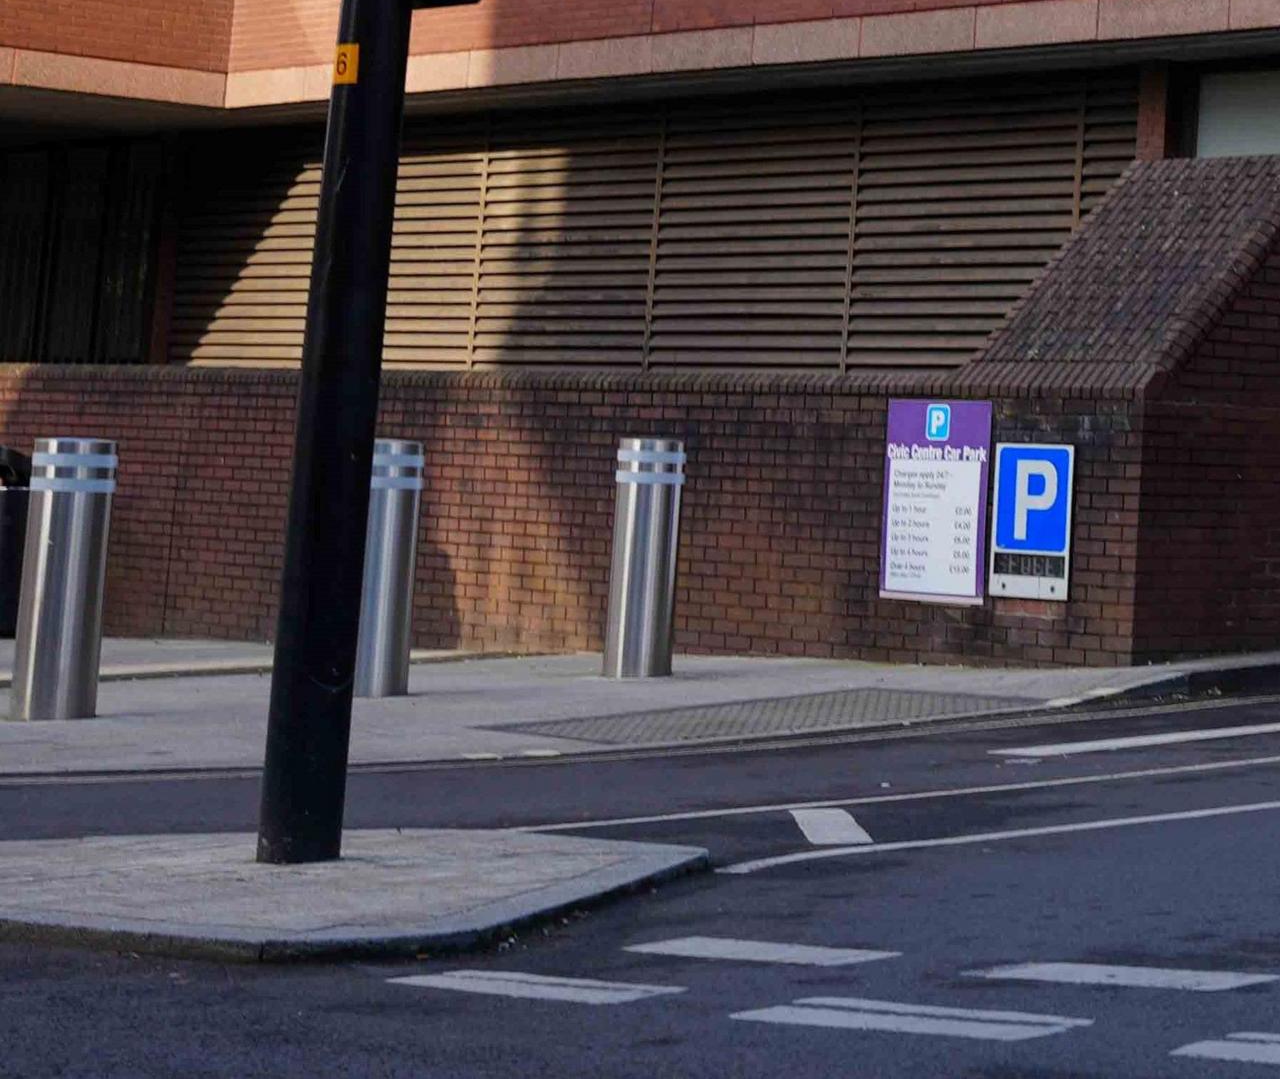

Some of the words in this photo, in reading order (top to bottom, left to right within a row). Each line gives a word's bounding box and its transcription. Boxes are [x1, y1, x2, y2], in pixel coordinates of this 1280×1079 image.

[931, 410, 945, 435] P
[888, 443, 910, 460] Civic
[911, 444, 942, 460] Centre
[944, 445, 961, 460] Car
[963, 445, 987, 462] Park
[1014, 459, 1058, 540] P
